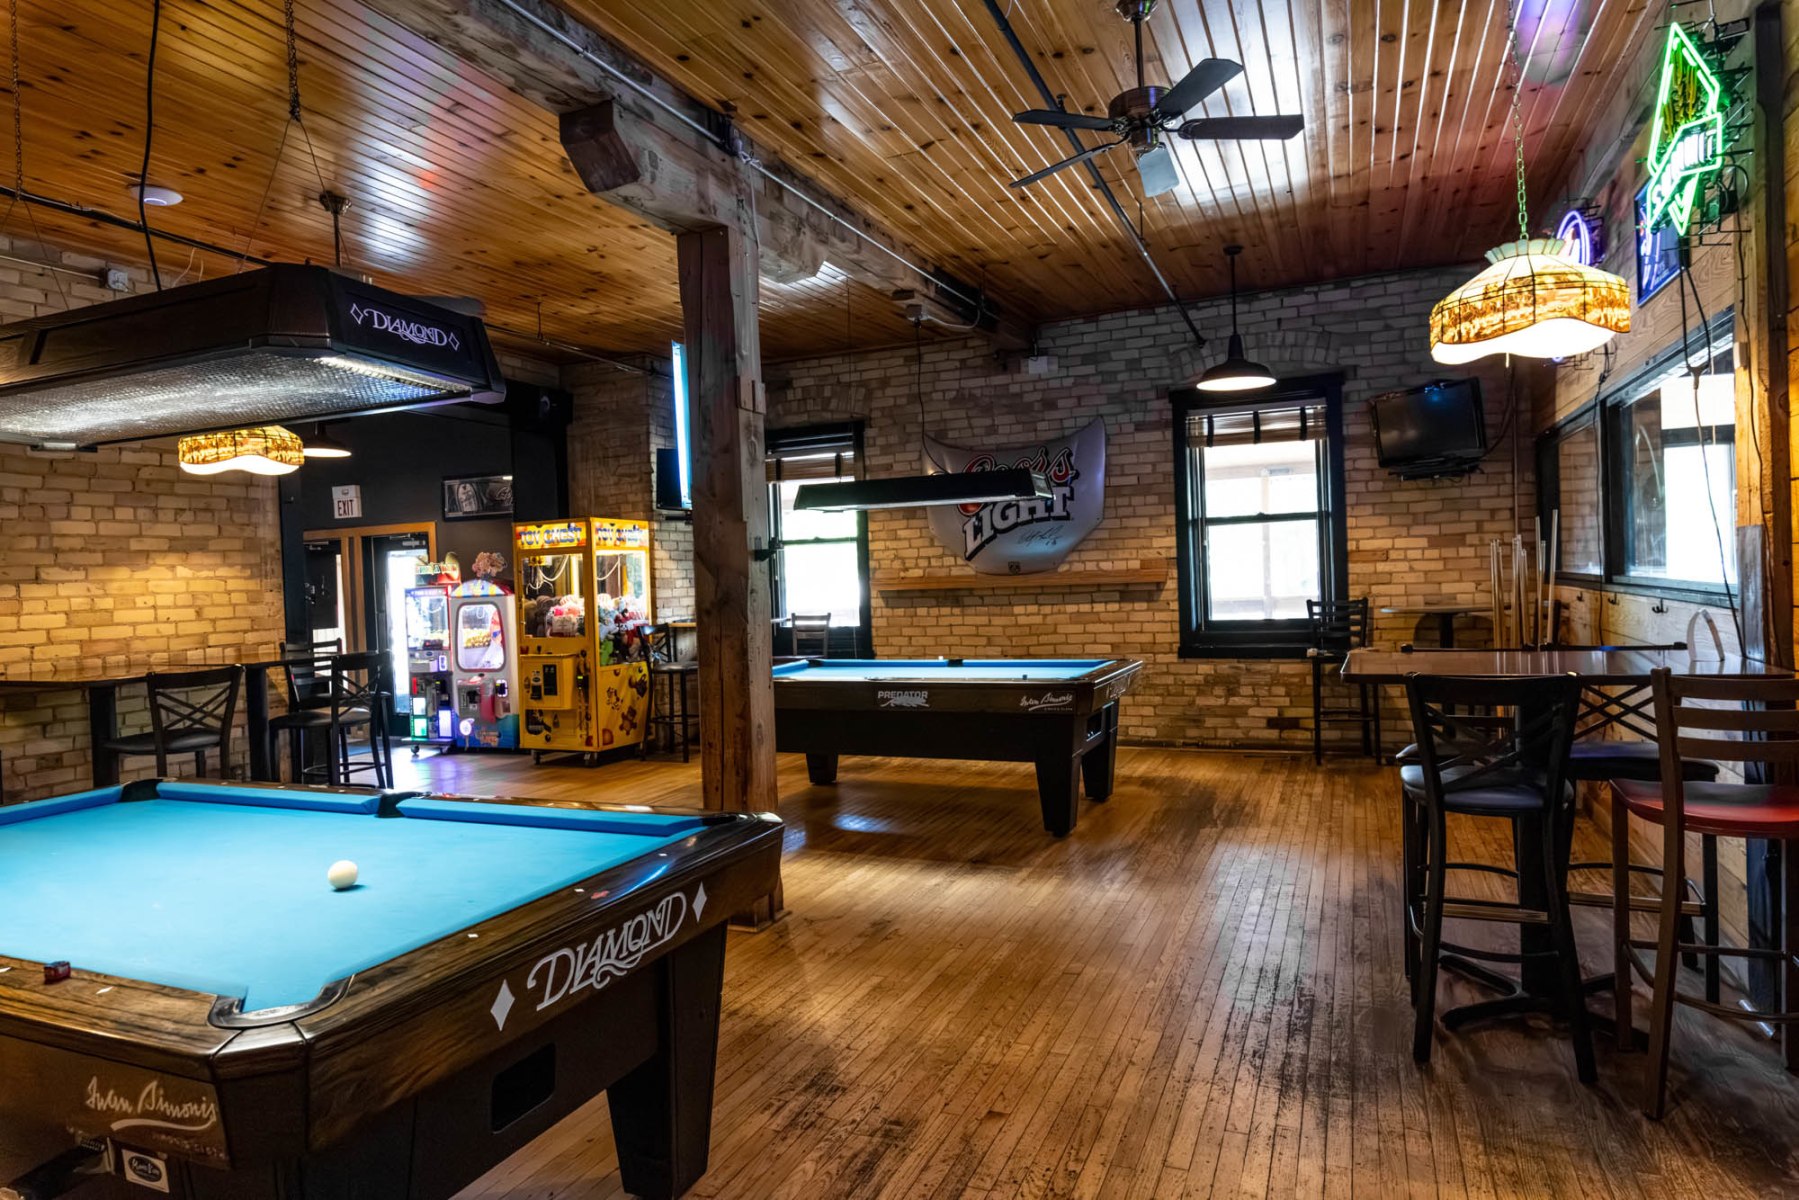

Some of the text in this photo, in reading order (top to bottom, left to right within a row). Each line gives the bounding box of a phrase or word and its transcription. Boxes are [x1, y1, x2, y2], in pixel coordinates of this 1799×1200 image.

[363, 308, 448, 346] DIAMOND
[337, 499, 354, 516] EXIT
[963, 485, 1072, 559] LIGHT
[519, 526, 582, 546] TOY CHEST
[877, 690, 928, 699] PREDATOR
[526, 891, 688, 1012] DIAMOND
[136, 1080, 217, 1122] Simonis
